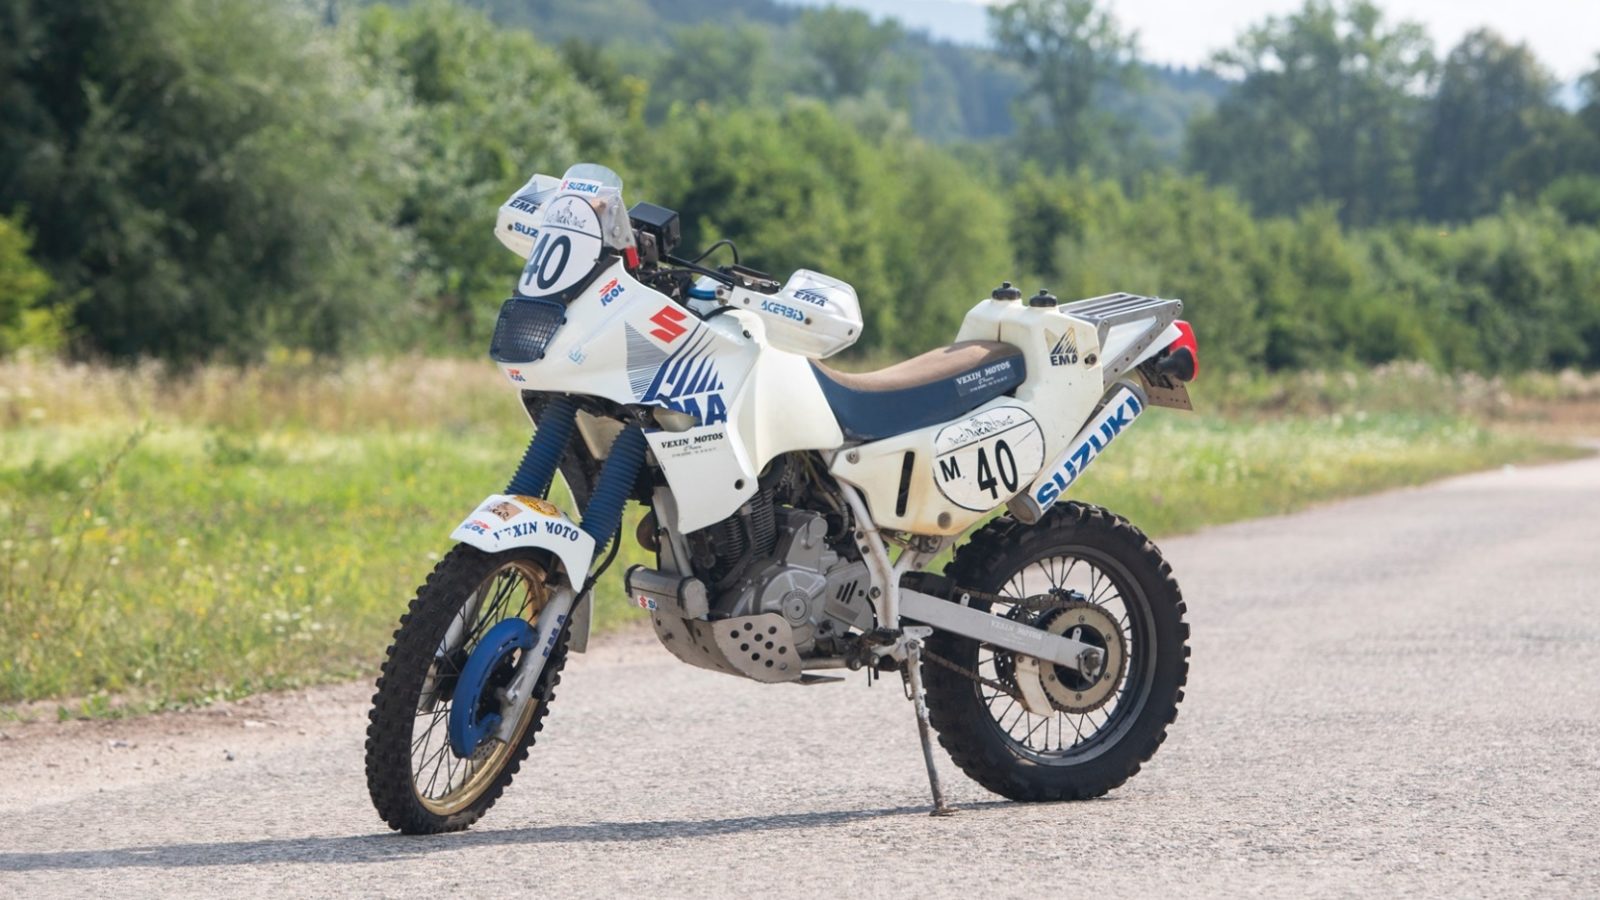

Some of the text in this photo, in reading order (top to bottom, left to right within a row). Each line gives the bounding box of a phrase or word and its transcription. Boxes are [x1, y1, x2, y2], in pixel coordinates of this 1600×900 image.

[567, 181, 599, 194] SUZUKI
[508, 199, 539, 215] EMA
[514, 222, 539, 237] SUZ
[525, 234, 571, 290] 40
[600, 284, 626, 307] IGOL
[793, 290, 826, 307] EMA
[1050, 354, 1078, 366] EMA
[955, 370, 982, 385] VEXIN
[985, 361, 1011, 377] MOTOS
[661, 438, 690, 449] VEXIN
[694, 432, 724, 444] MOTOS
[1036, 396, 1142, 505] SUZUKI
[977, 439, 1019, 500] 40
[545, 521, 579, 542] MOTO
